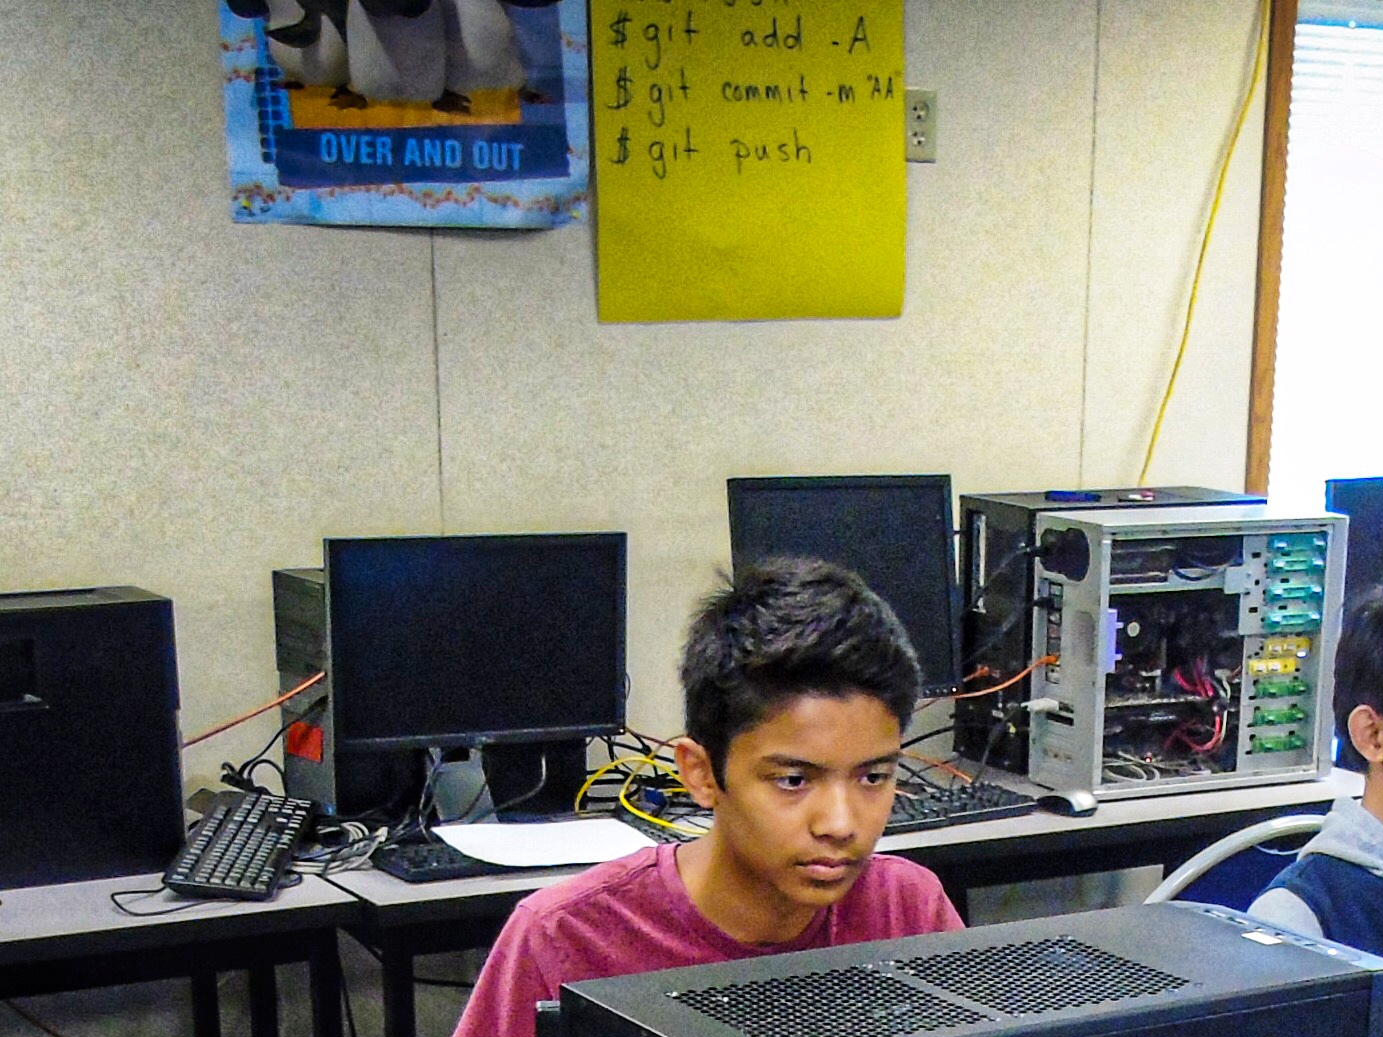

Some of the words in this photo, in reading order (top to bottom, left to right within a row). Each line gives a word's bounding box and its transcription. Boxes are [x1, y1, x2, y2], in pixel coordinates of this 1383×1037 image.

[741, 17, 801, 50] add
[722, 75, 809, 102] commit
[320, 132, 393, 166] OVER
[404, 137, 463, 169] AND
[473, 140, 524, 172] OUT
[730, 129, 811, 175] push
